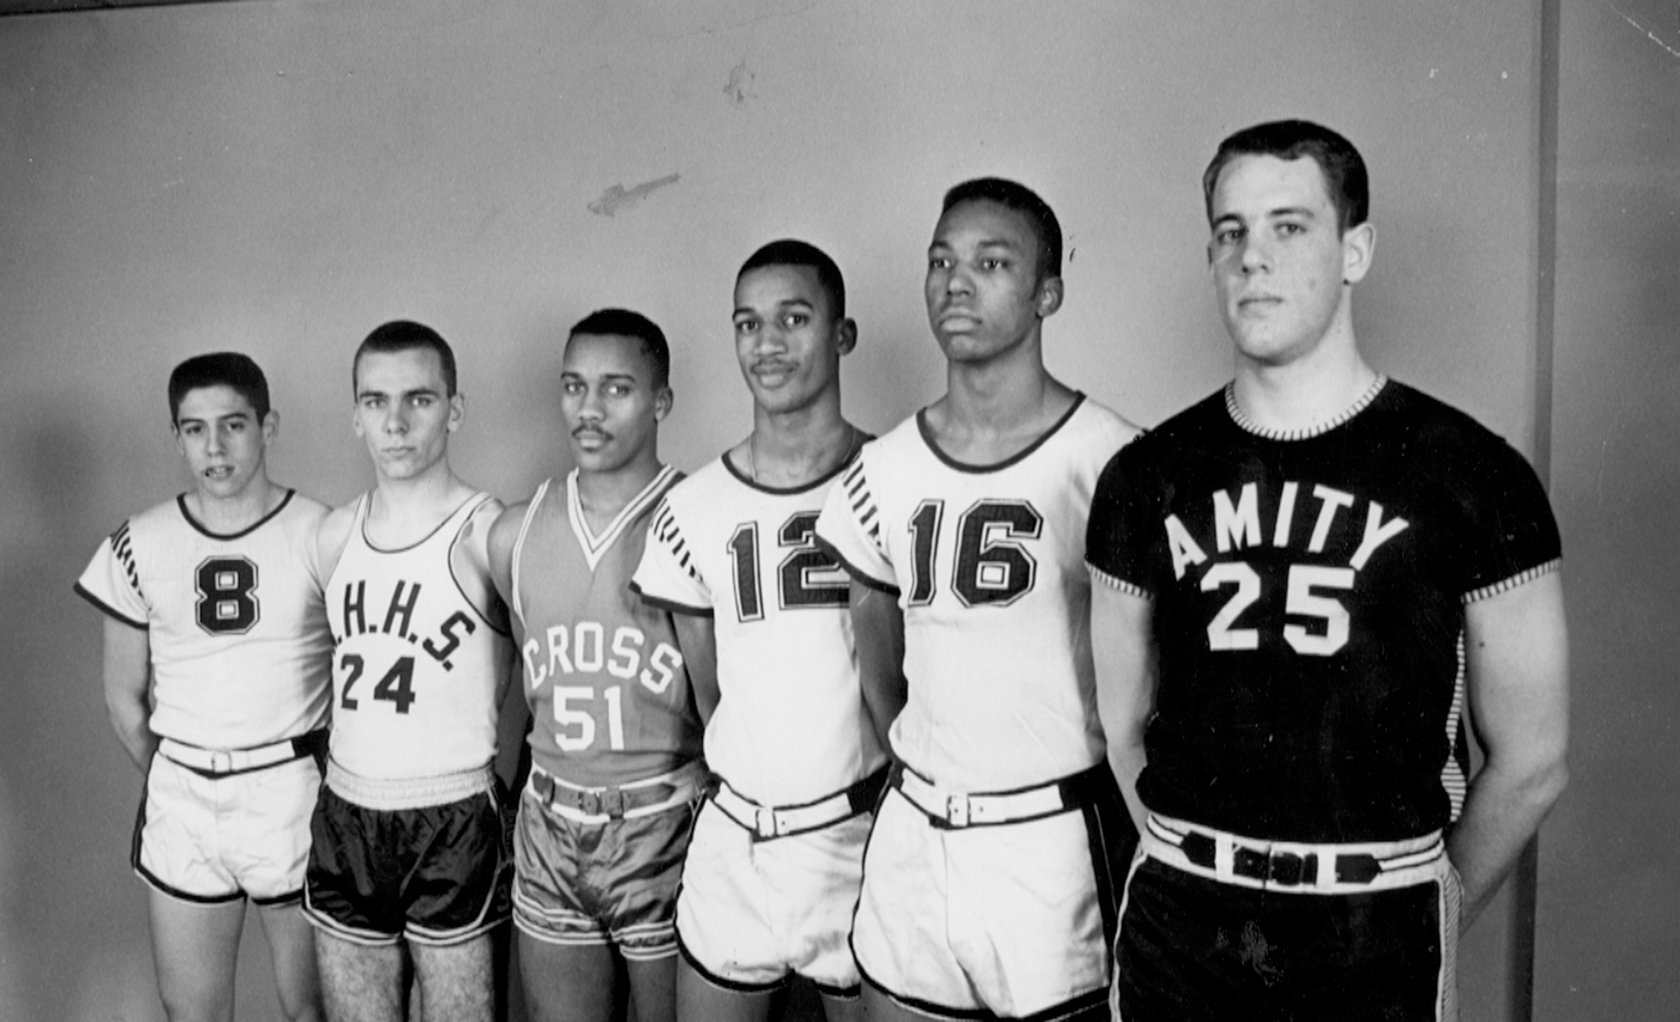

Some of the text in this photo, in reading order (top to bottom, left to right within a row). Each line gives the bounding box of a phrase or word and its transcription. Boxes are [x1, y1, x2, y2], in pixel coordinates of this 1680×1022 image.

[726, 510, 851, 623] 12
[906, 498, 1043, 608] 16
[1164, 481, 1410, 581] AMITY
[194, 555, 260, 636] 8
[336, 579, 477, 672] .H.H.S.
[1200, 561, 1356, 656] 25
[340, 653, 416, 714] 24
[523, 621, 683, 694] CROSS
[553, 685, 625, 752] 51
